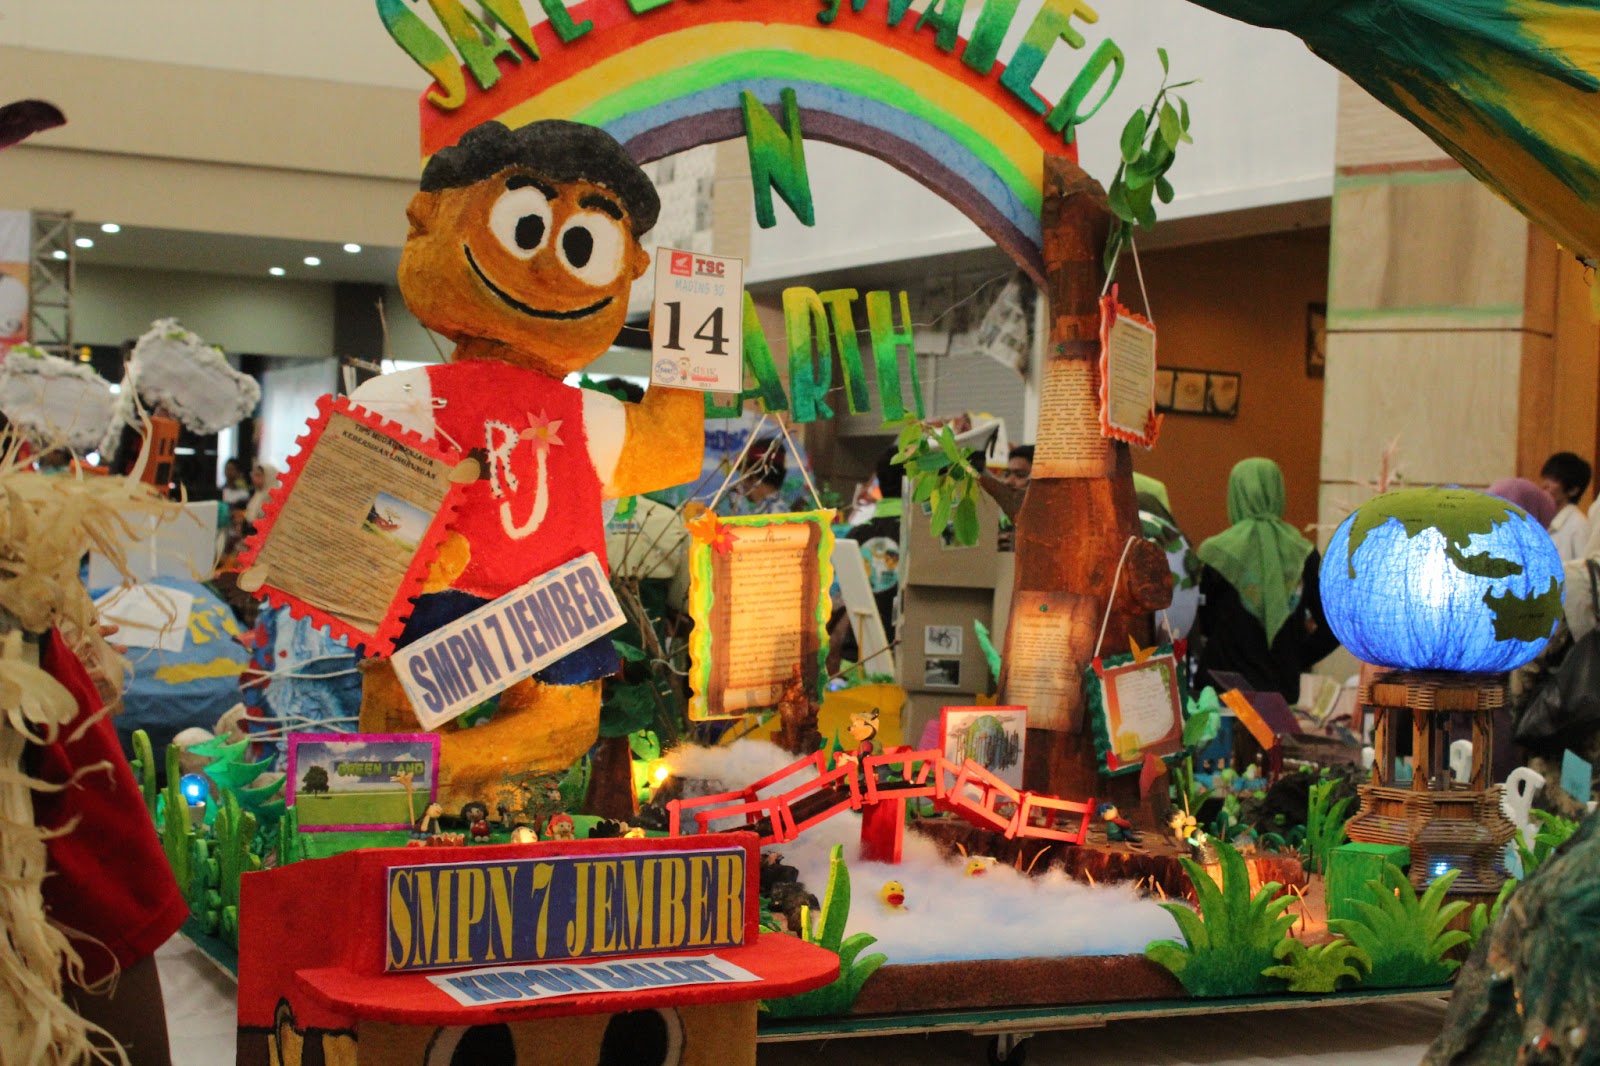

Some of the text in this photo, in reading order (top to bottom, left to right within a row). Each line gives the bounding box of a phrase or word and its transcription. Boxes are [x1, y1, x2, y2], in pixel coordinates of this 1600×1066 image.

[738, 86, 815, 229] N
[695, 258, 725, 276] TSC
[662, 301, 729, 356] 14
[704, 286, 925, 422] ARTH
[354, 423, 372, 436] TIPS
[408, 566, 615, 714] SMPN 7 JEMBER
[337, 762, 382, 777] GREEN
[389, 854, 744, 969] SMPN 7 JEMBER
[446, 960, 736, 1002] KUPON BALLOT
